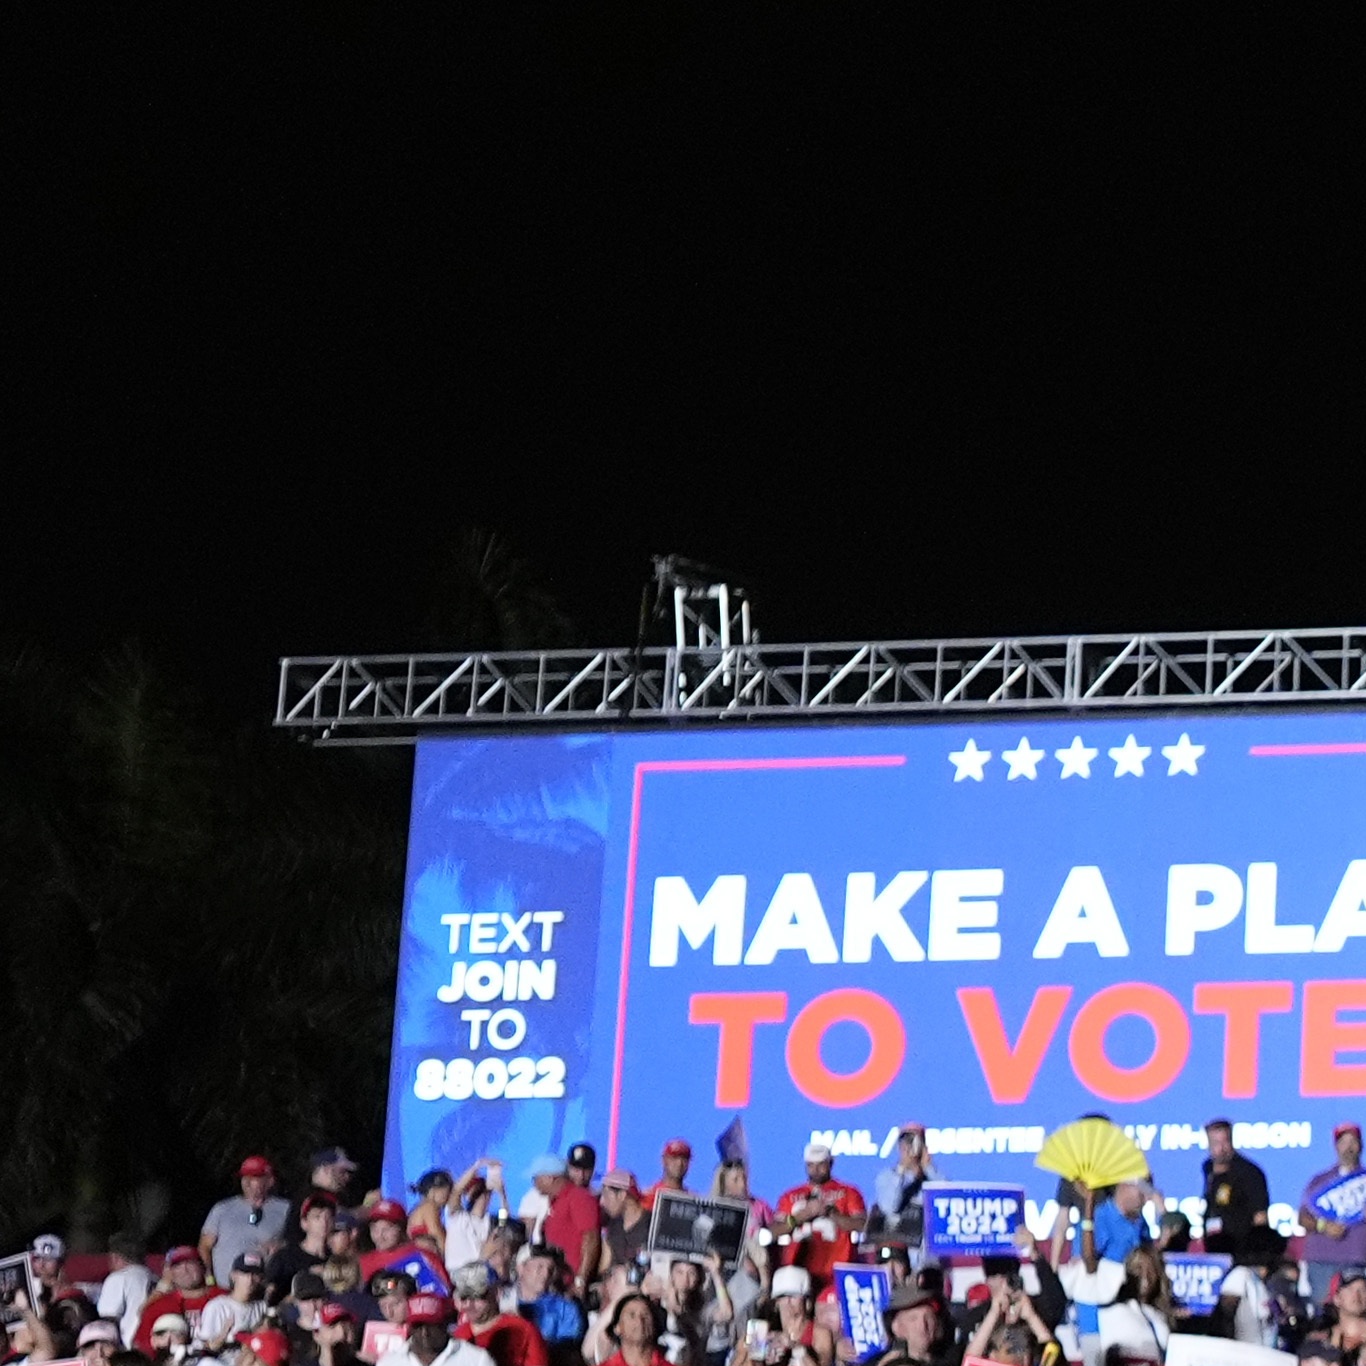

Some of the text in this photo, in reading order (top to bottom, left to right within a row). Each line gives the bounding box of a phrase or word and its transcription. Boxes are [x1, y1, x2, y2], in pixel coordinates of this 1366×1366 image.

[440, 910, 564, 955] TEXT
[649, 868, 1004, 967] MAKE
[1032, 865, 1130, 959] A
[437, 959, 557, 1003] JOIN
[460, 1008, 527, 1051] TO
[688, 987, 906, 1109] TO
[413, 1056, 567, 1101] 88022
[925, 1126, 1046, 1154] BSENTEE
[933, 1197, 1018, 1219] TRUMP
[946, 1214, 1008, 1236] 2024
[1165, 1263, 1223, 1282] RUMP
[1172, 1279, 1213, 1298] 024
